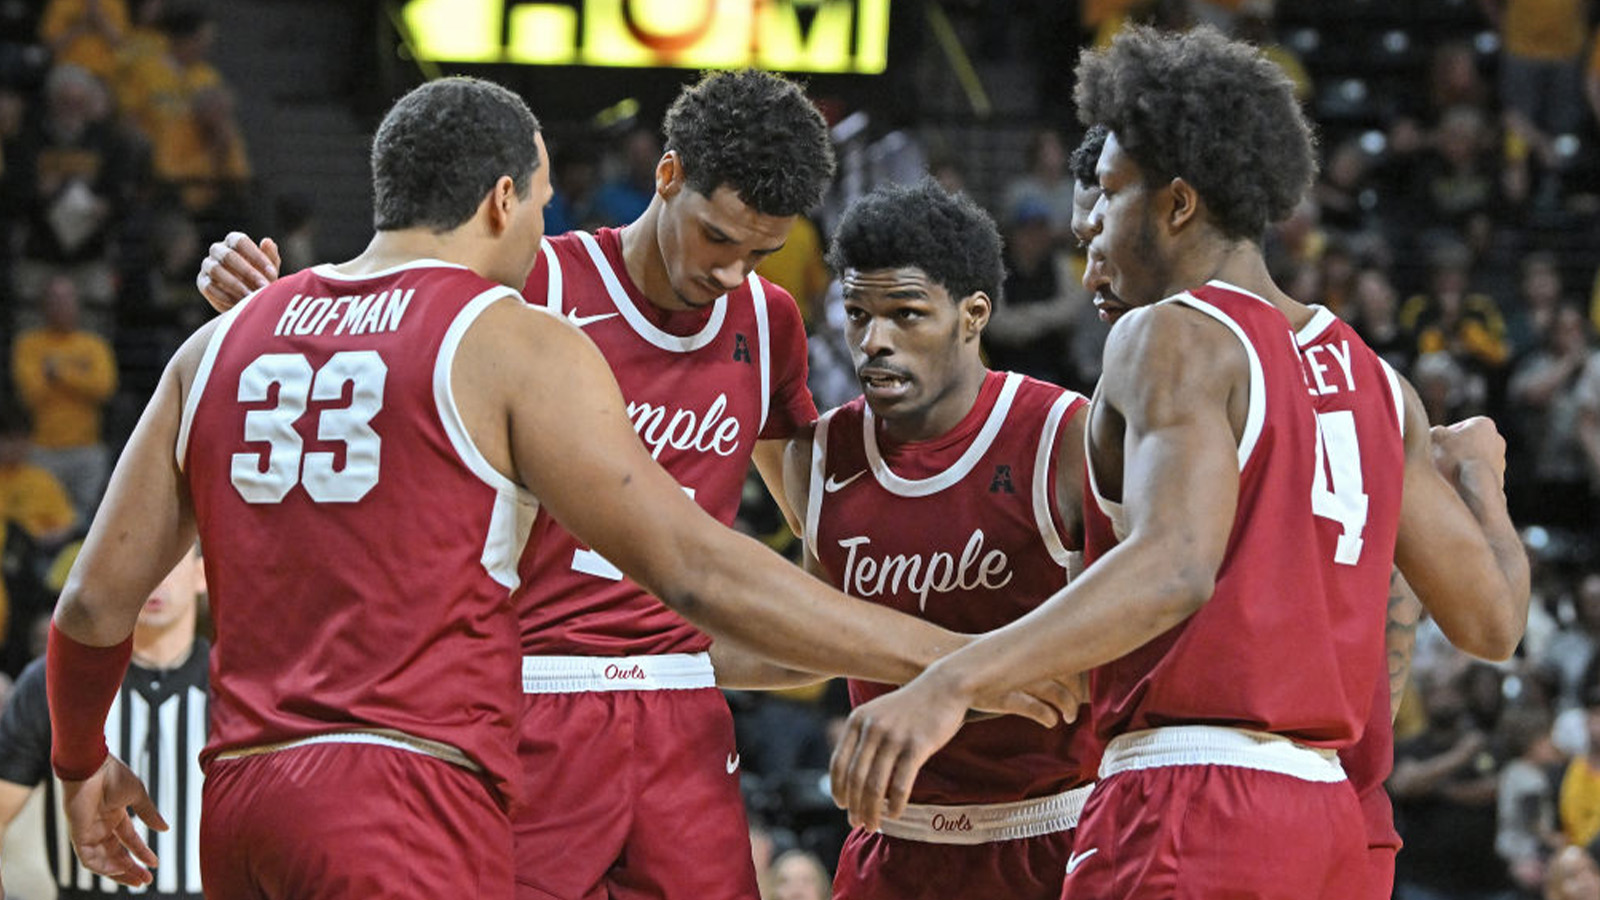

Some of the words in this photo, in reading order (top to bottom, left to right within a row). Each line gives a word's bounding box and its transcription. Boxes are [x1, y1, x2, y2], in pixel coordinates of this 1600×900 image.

[273, 288, 416, 336] HOFMAN
[230, 350, 388, 504] 33
[625, 392, 740, 461] mple
[1310, 408, 1369, 567] 4
[837, 528, 1013, 613] Temple
[604, 663, 647, 680] Owls
[931, 813, 974, 831] Owls
